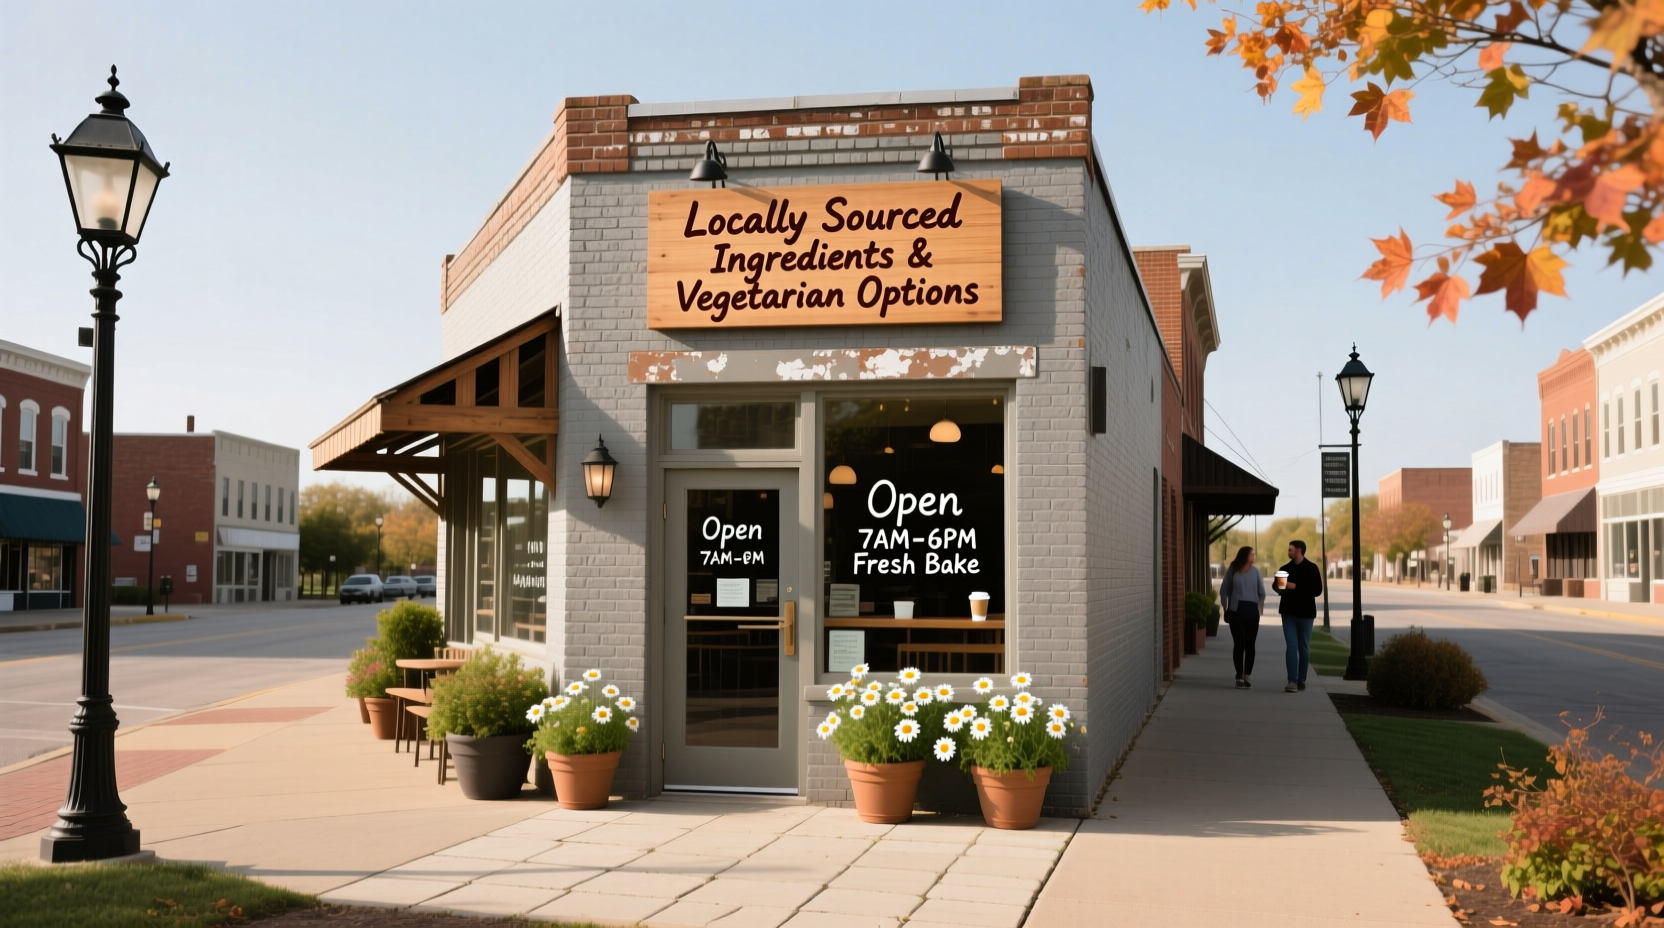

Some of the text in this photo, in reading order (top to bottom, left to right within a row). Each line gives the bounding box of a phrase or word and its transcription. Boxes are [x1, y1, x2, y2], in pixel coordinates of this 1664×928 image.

[684, 191, 963, 246] Locally Sourced
[709, 237, 933, 284] Ingredients &
[676, 275, 980, 323] Vegetarian Options
[867, 479, 963, 527] Open
[702, 515, 763, 550] Open
[858, 527, 977, 551] 7AM-6PM
[853, 551, 981, 575] Fresh Bake
